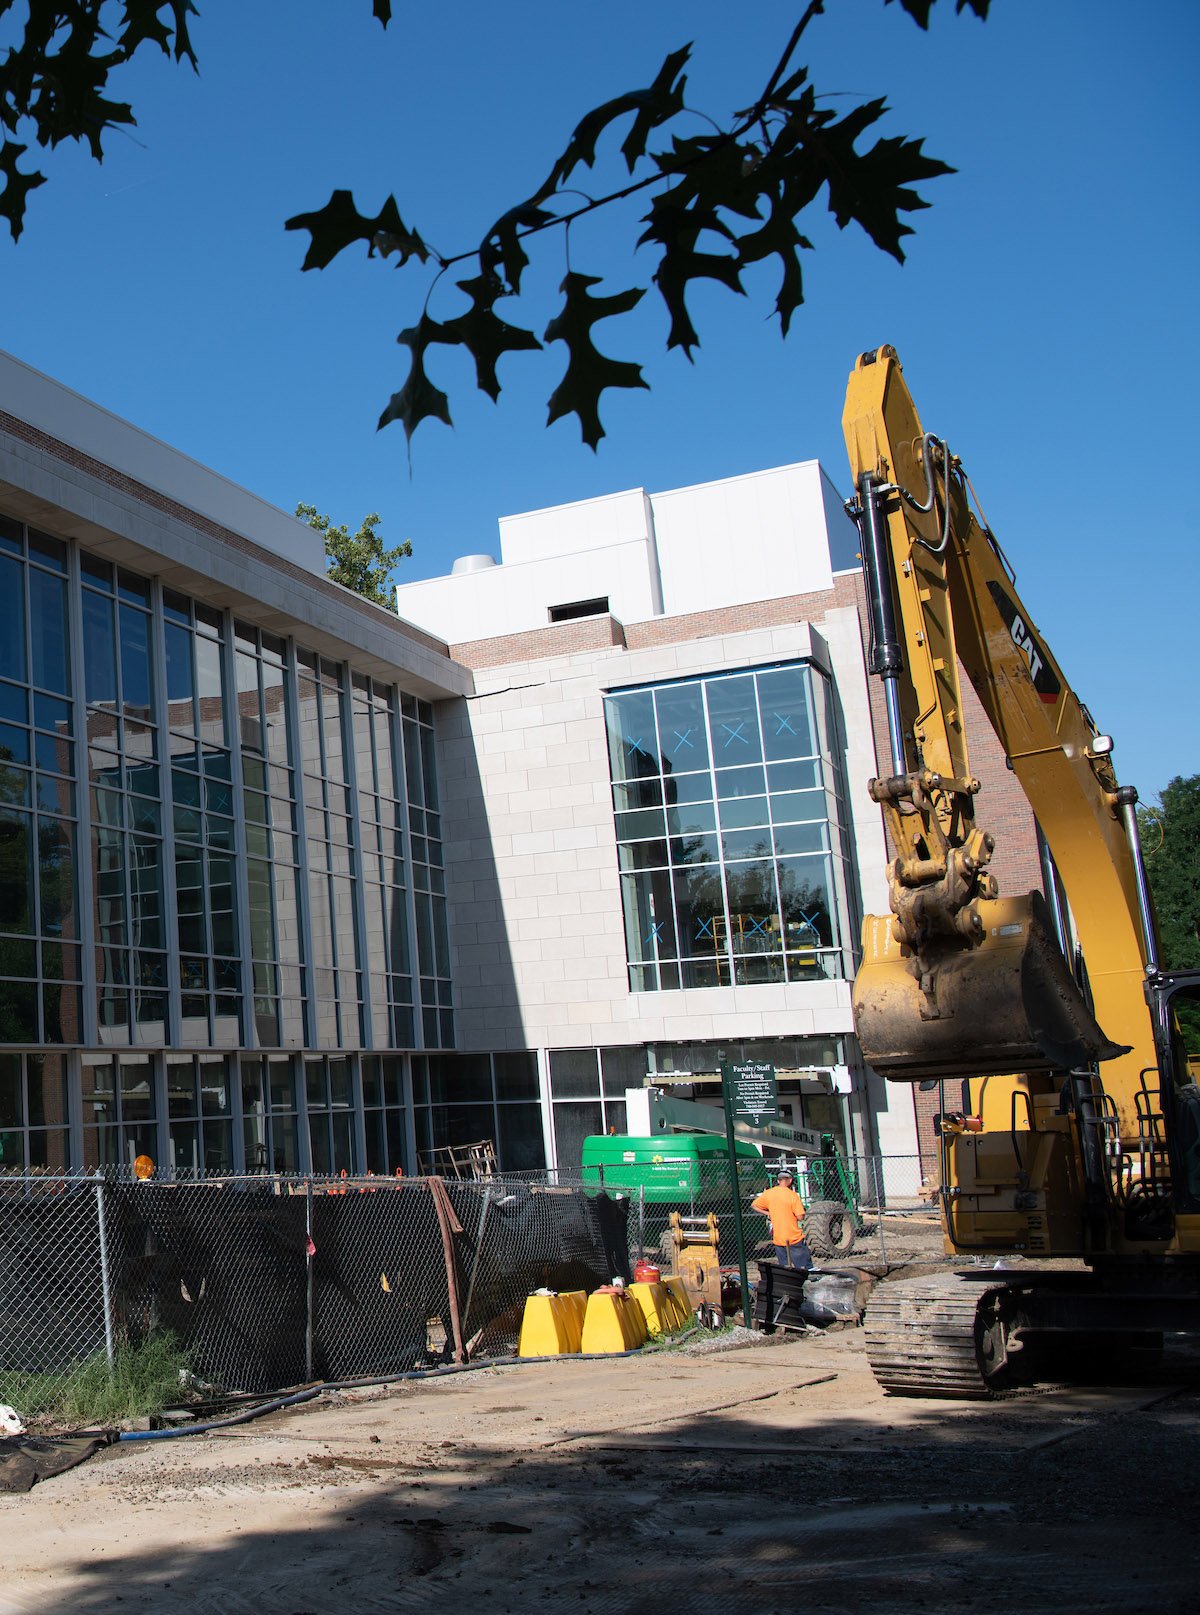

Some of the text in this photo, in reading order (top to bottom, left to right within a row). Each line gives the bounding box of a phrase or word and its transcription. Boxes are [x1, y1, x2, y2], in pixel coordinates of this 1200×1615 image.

[1010, 614, 1043, 682] CAT
[733, 1064, 771, 1073] Faculty/Staff
[741, 1071, 765, 1081] Parking
[793, 1130, 814, 1145] RENTALS
